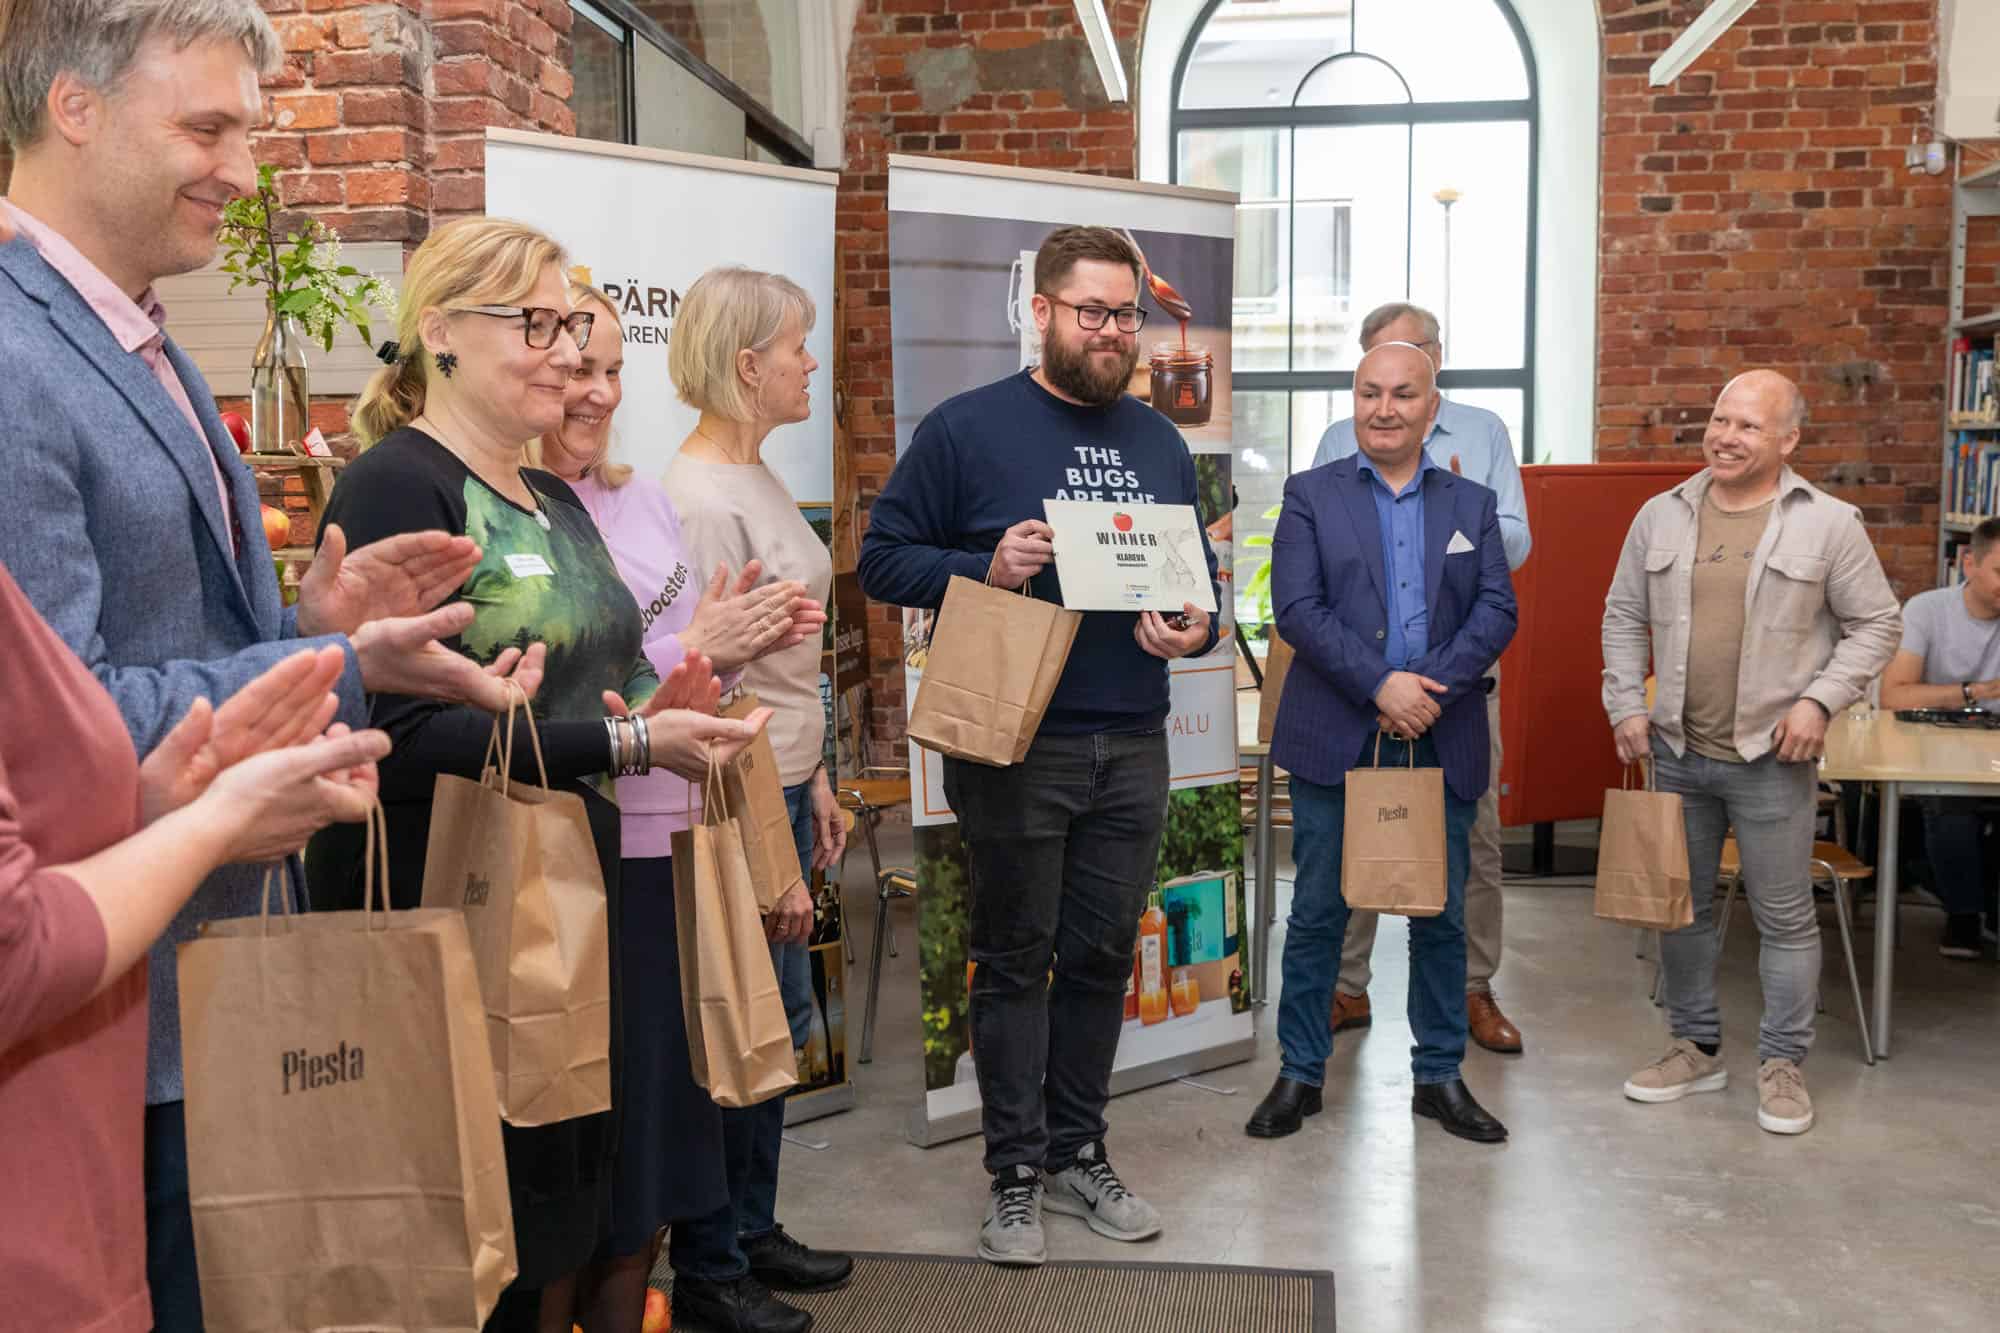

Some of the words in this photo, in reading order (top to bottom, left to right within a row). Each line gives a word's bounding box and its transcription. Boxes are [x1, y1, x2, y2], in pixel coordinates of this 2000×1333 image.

[1073, 446, 1123, 466] THE
[1065, 467, 1139, 489] BUGS
[1096, 532, 1158, 547] WINNER
[1168, 713, 1209, 736] ALU
[282, 1040, 364, 1095] Piesta
